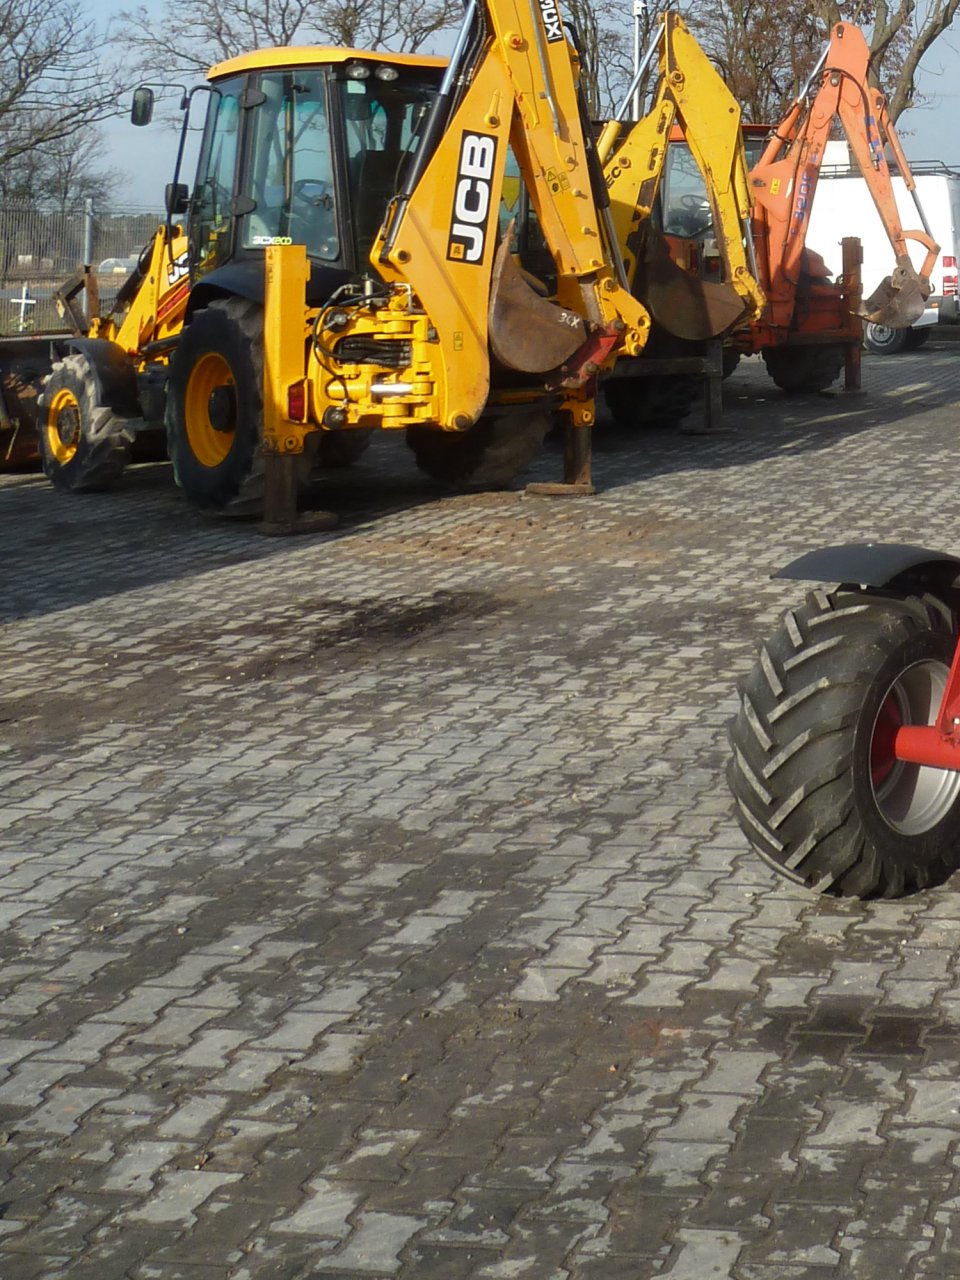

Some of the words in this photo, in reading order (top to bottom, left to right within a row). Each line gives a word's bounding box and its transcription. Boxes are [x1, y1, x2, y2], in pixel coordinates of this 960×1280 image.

[452, 135, 495, 261] JCB
[169, 252, 190, 284] JC
[558, 312, 580, 328] 3CX
